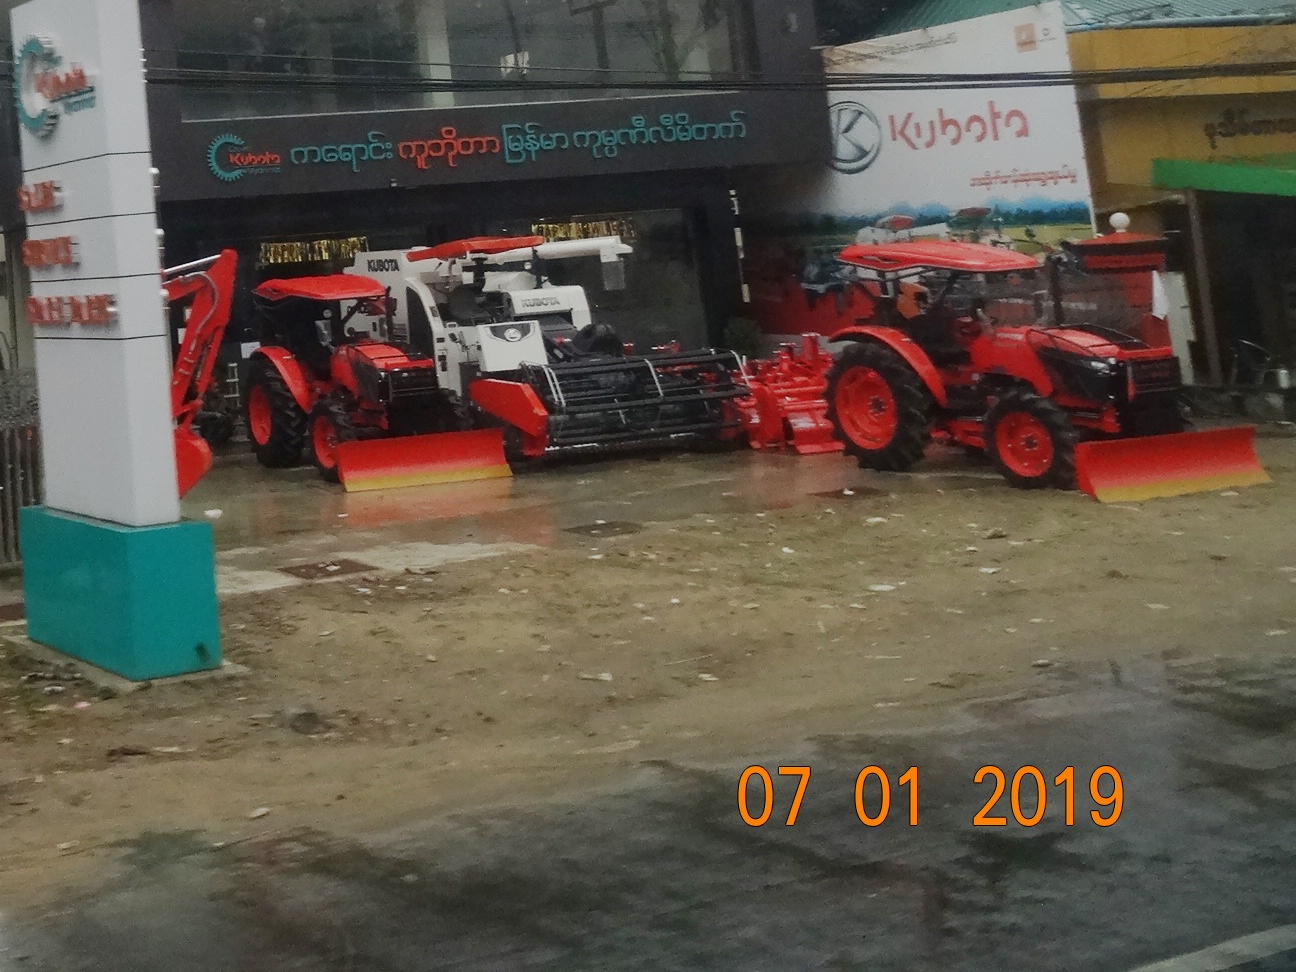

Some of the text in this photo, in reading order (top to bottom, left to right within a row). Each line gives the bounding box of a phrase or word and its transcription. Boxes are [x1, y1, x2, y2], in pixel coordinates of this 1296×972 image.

[888, 100, 1029, 150] Kubota
[228, 151, 281, 166] Kubota
[367, 258, 401, 272] KUBOTA
[520, 296, 561, 308] KUBOTA
